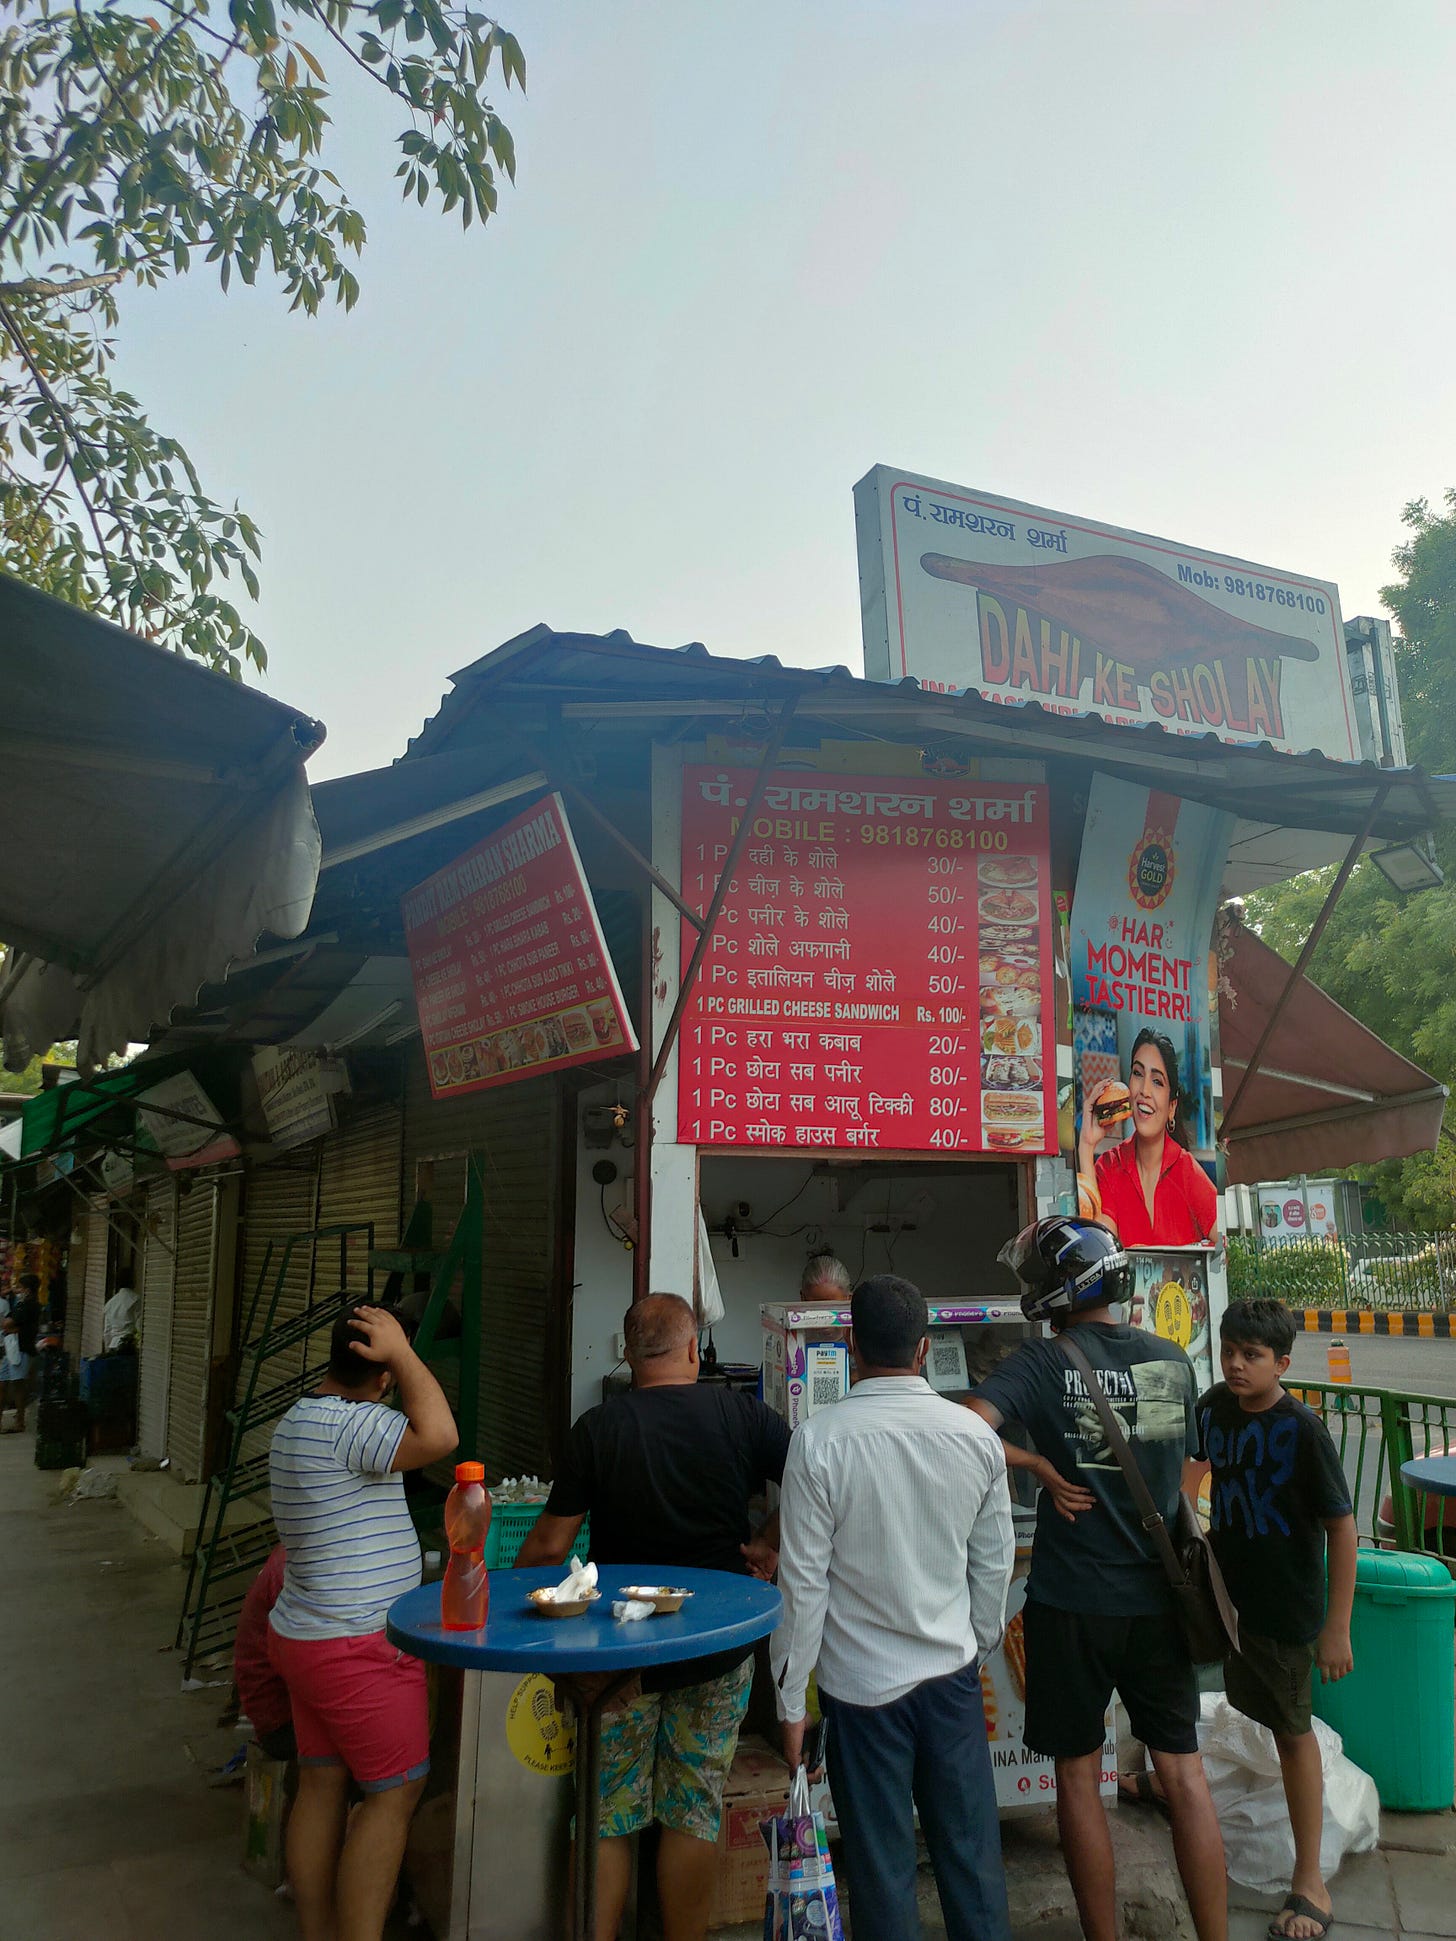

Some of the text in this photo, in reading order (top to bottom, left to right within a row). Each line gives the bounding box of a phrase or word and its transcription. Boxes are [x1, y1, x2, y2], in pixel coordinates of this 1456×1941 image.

[929, 503, 1016, 541] रामशरन
[1026, 529, 1068, 553] शर्मा
[1177, 563, 1326, 615] Mob: 9818768100
[976, 589, 1286, 740] DAHI KE SHOLAY
[698, 773, 748, 807] पं.
[764, 786, 937, 819] रामशरन
[949, 790, 1037, 823] शर्मा
[501, 810, 562, 872] SHARMA
[731, 816, 835, 843] MOBILE
[861, 824, 1008, 851] 9818768100
[697, 844, 964, 875] 1 P दही के शोले 30/-
[1141, 856, 1166, 874] Harvest
[696, 874, 704, 891] 1
[790, 875, 804, 897] के
[814, 876, 845, 900] शोले
[927, 886, 964, 904] 50/-
[1140, 869, 1163, 884] GOLD
[696, 904, 704, 919] 1
[748, 904, 786, 926] पनीर
[793, 905, 809, 928] के
[818, 906, 850, 930] शोले
[927, 916, 965, 934] 40/-
[1121, 916, 1164, 950] HAR
[713, 933, 965, 964] Pc शोले अफगानी 40/-
[698, 964, 703, 982] 1
[712, 965, 738, 985] Pc
[747, 965, 815, 989] इतालियन
[865, 969, 896, 992] शोले
[928, 976, 966, 994] 50/-
[1087, 938, 1192, 991] MOMENT
[698, 996, 967, 1024] 1 PC GRILLED CHEESE SANDWICH Rs. 100/-
[1085, 974, 1192, 1023] TASTIERR!
[694, 1026, 967, 1055] 1 Pc हरा भरा कबाब 20/-
[693, 1056, 968, 1086] 1 Pc छोटा सब पनीर 80/-
[692, 1087, 968, 1121] 1 Pc छोटा सब आलू टिक्की 80/-
[692, 1119, 968, 1148] 1 Pc स्मोक हाउस बर्गर 40/-
[993, 1750, 1018, 1768] INA
